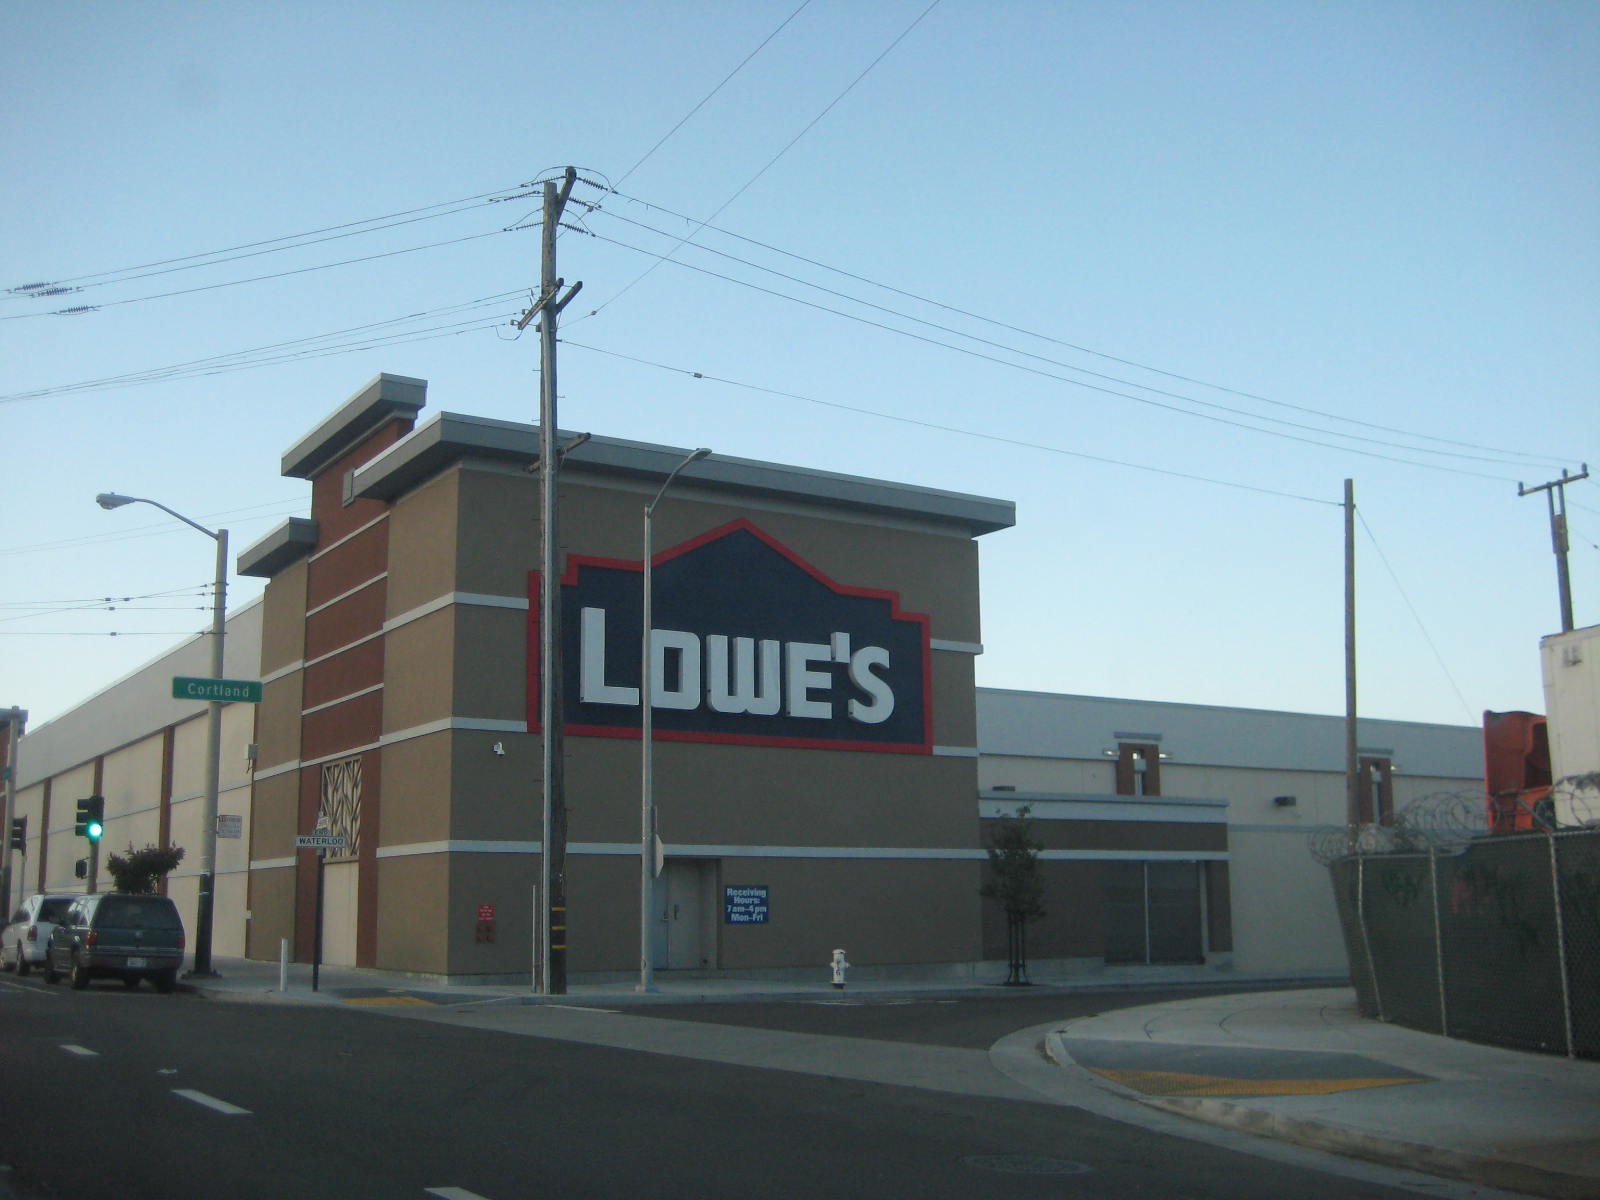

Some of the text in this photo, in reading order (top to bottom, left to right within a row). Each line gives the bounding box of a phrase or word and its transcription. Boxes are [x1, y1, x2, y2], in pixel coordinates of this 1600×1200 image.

[580, 606, 895, 724] LOWE'S
[187, 682, 249, 697] Cortland
[299, 837, 344, 846] WATERLOO
[726, 887, 767, 898] Receiving
